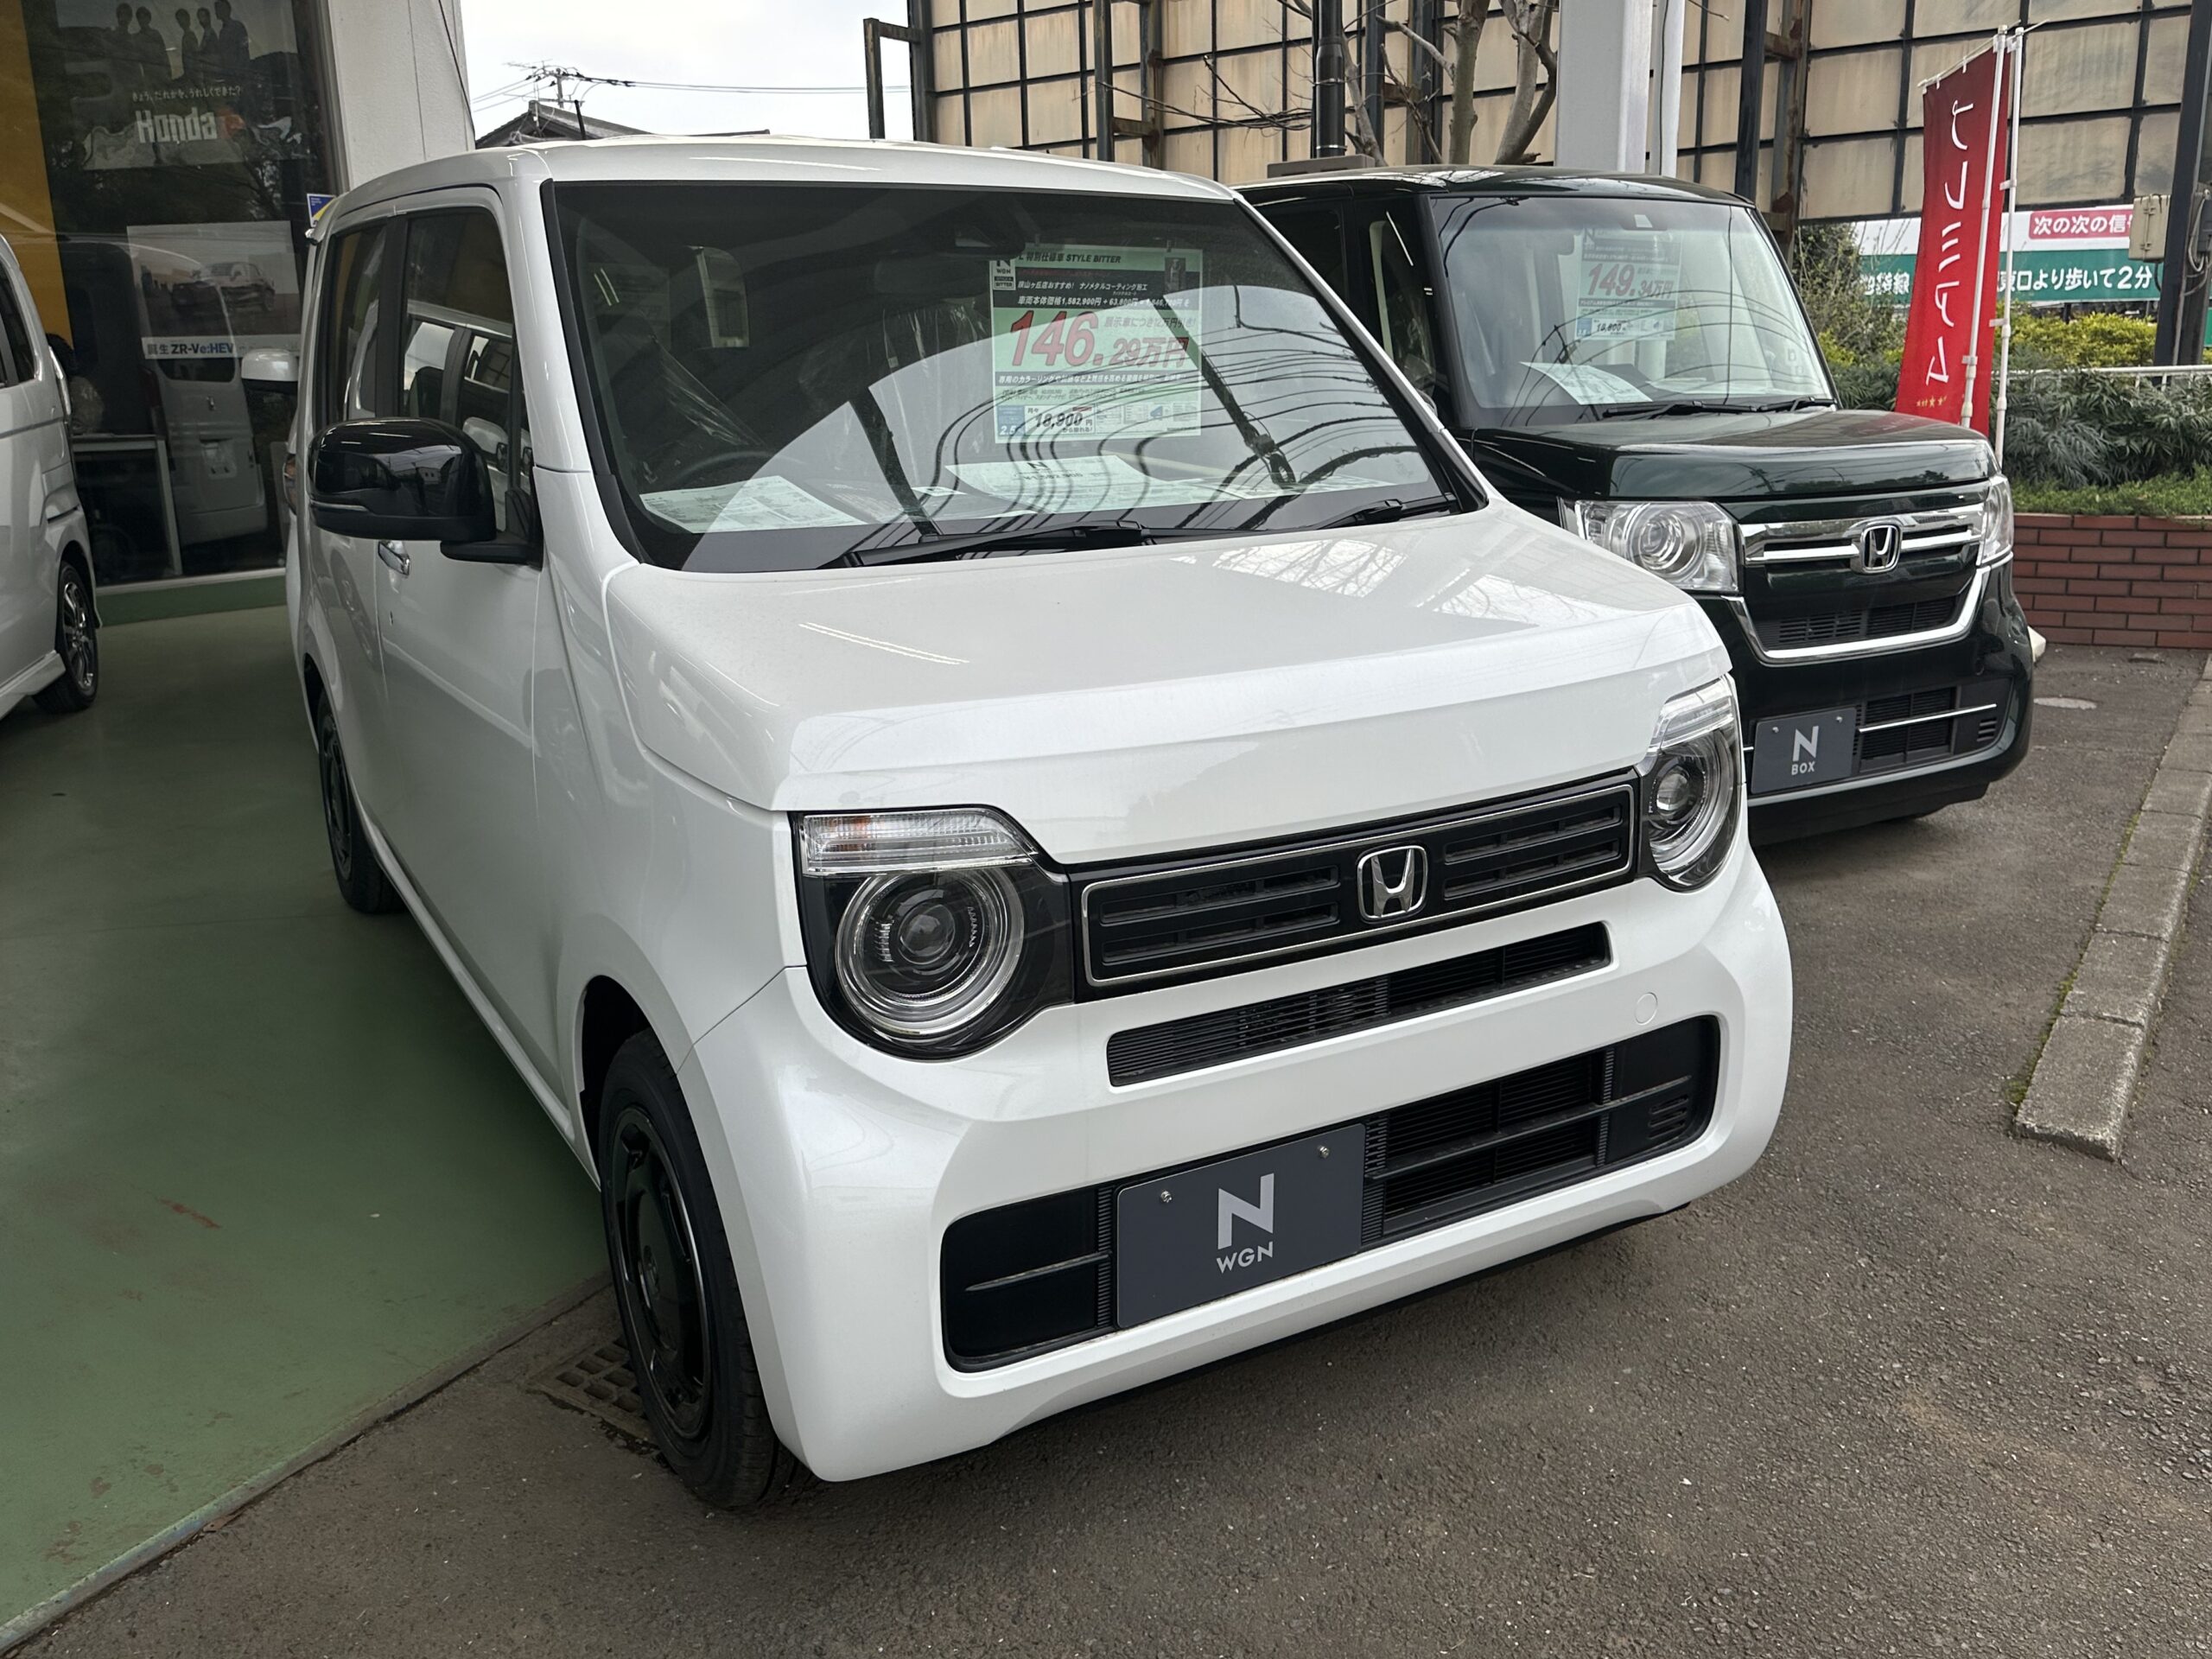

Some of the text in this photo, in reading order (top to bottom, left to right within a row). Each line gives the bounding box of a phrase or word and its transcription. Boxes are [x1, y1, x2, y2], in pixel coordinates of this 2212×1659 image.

[135, 106, 218, 143] Honda
[2033, 213, 2133, 235] 次の次の信
[1066, 254, 1091, 263] STYLE
[1093, 255, 1122, 264] BITTER
[1793, 725, 1819, 761] N
[1791, 761, 1815, 775] BOX
[1217, 1173, 1274, 1249] N
[1216, 1241, 1273, 1274] WGN
